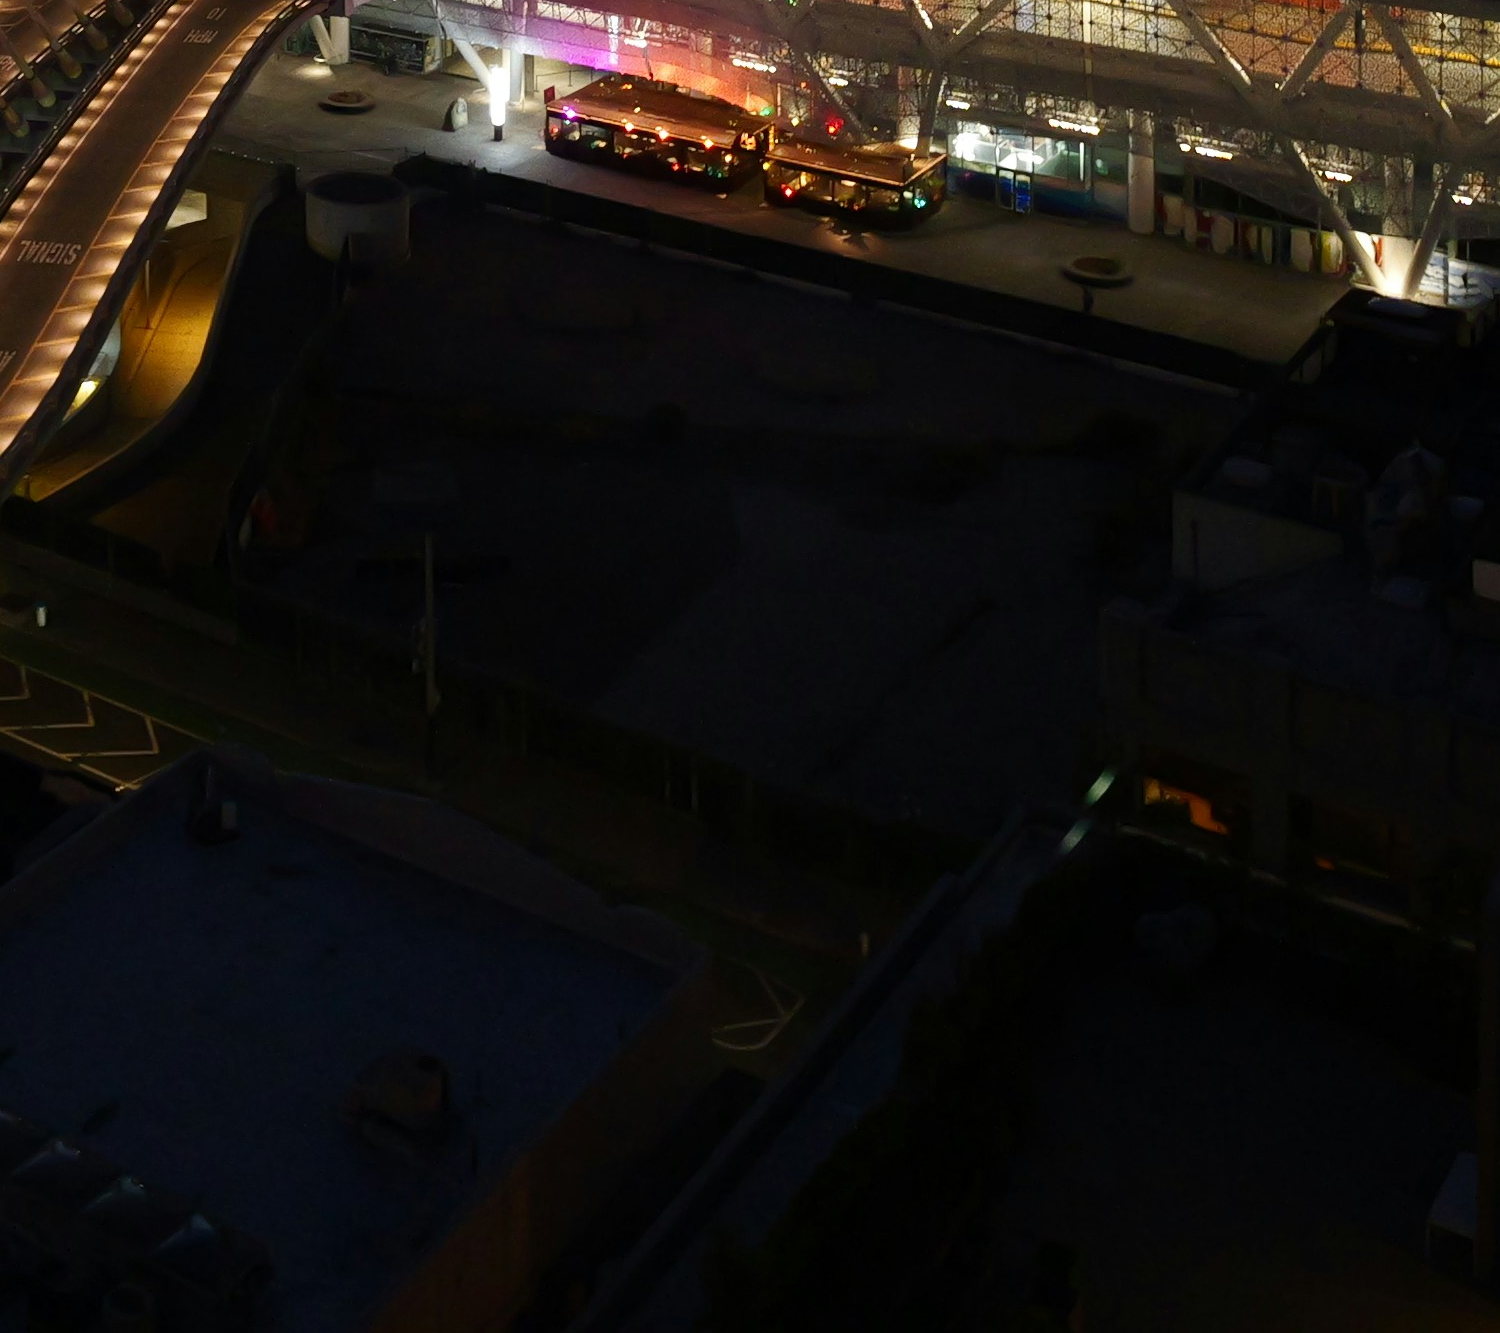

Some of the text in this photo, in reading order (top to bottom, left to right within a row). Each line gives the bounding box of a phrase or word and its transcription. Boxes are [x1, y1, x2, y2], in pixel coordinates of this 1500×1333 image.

[206, 7, 227, 21] 10
[183, 29, 218, 44] MPH
[17, 239, 82, 265] SIGNAL
